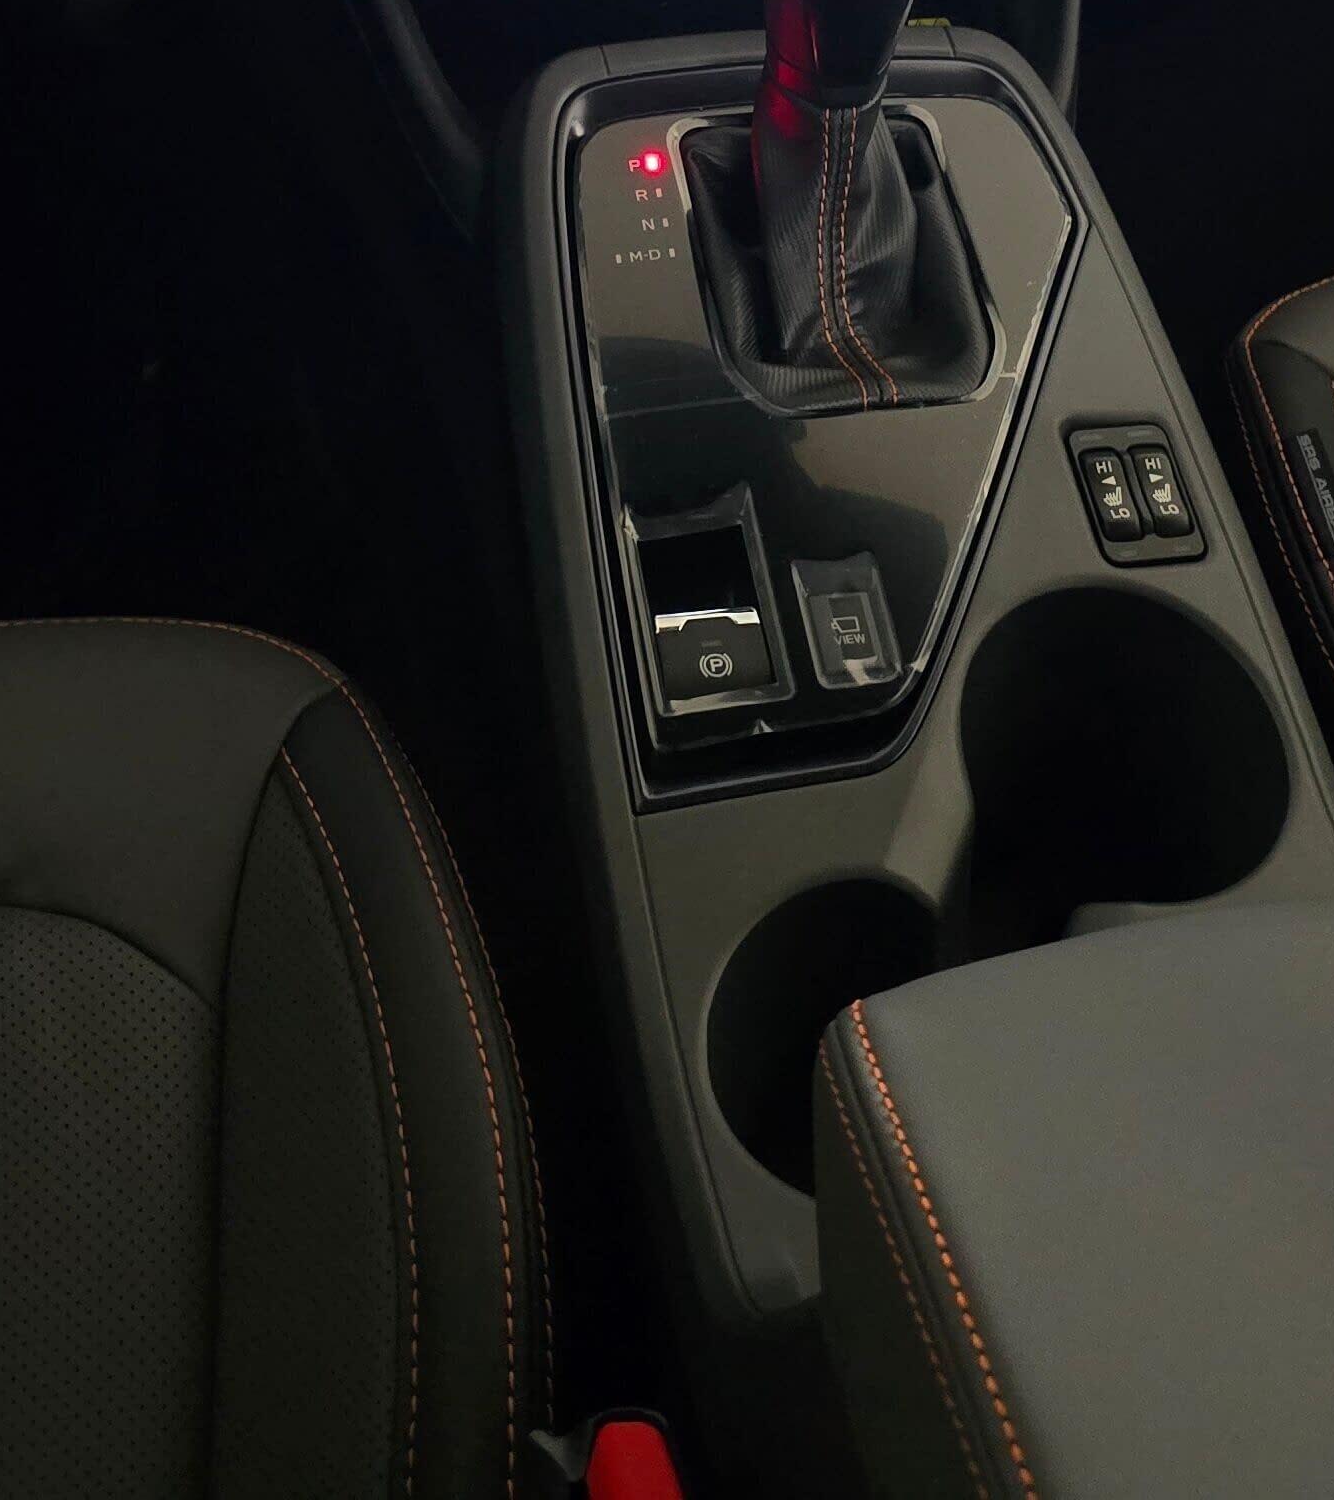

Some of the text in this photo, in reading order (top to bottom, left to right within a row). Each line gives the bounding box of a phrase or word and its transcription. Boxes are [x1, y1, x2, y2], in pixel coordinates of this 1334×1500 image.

[628, 159, 641, 173] P
[635, 189, 649, 202] R
[642, 219, 655, 231] N
[629, 250, 661, 263] M-D
[1296, 434, 1321, 469] SRS
[1095, 460, 1113, 475] HI
[1144, 457, 1162, 471] HI
[1110, 506, 1131, 520] LO
[1159, 503, 1180, 516] LO
[833, 634, 866, 646] VIEW
